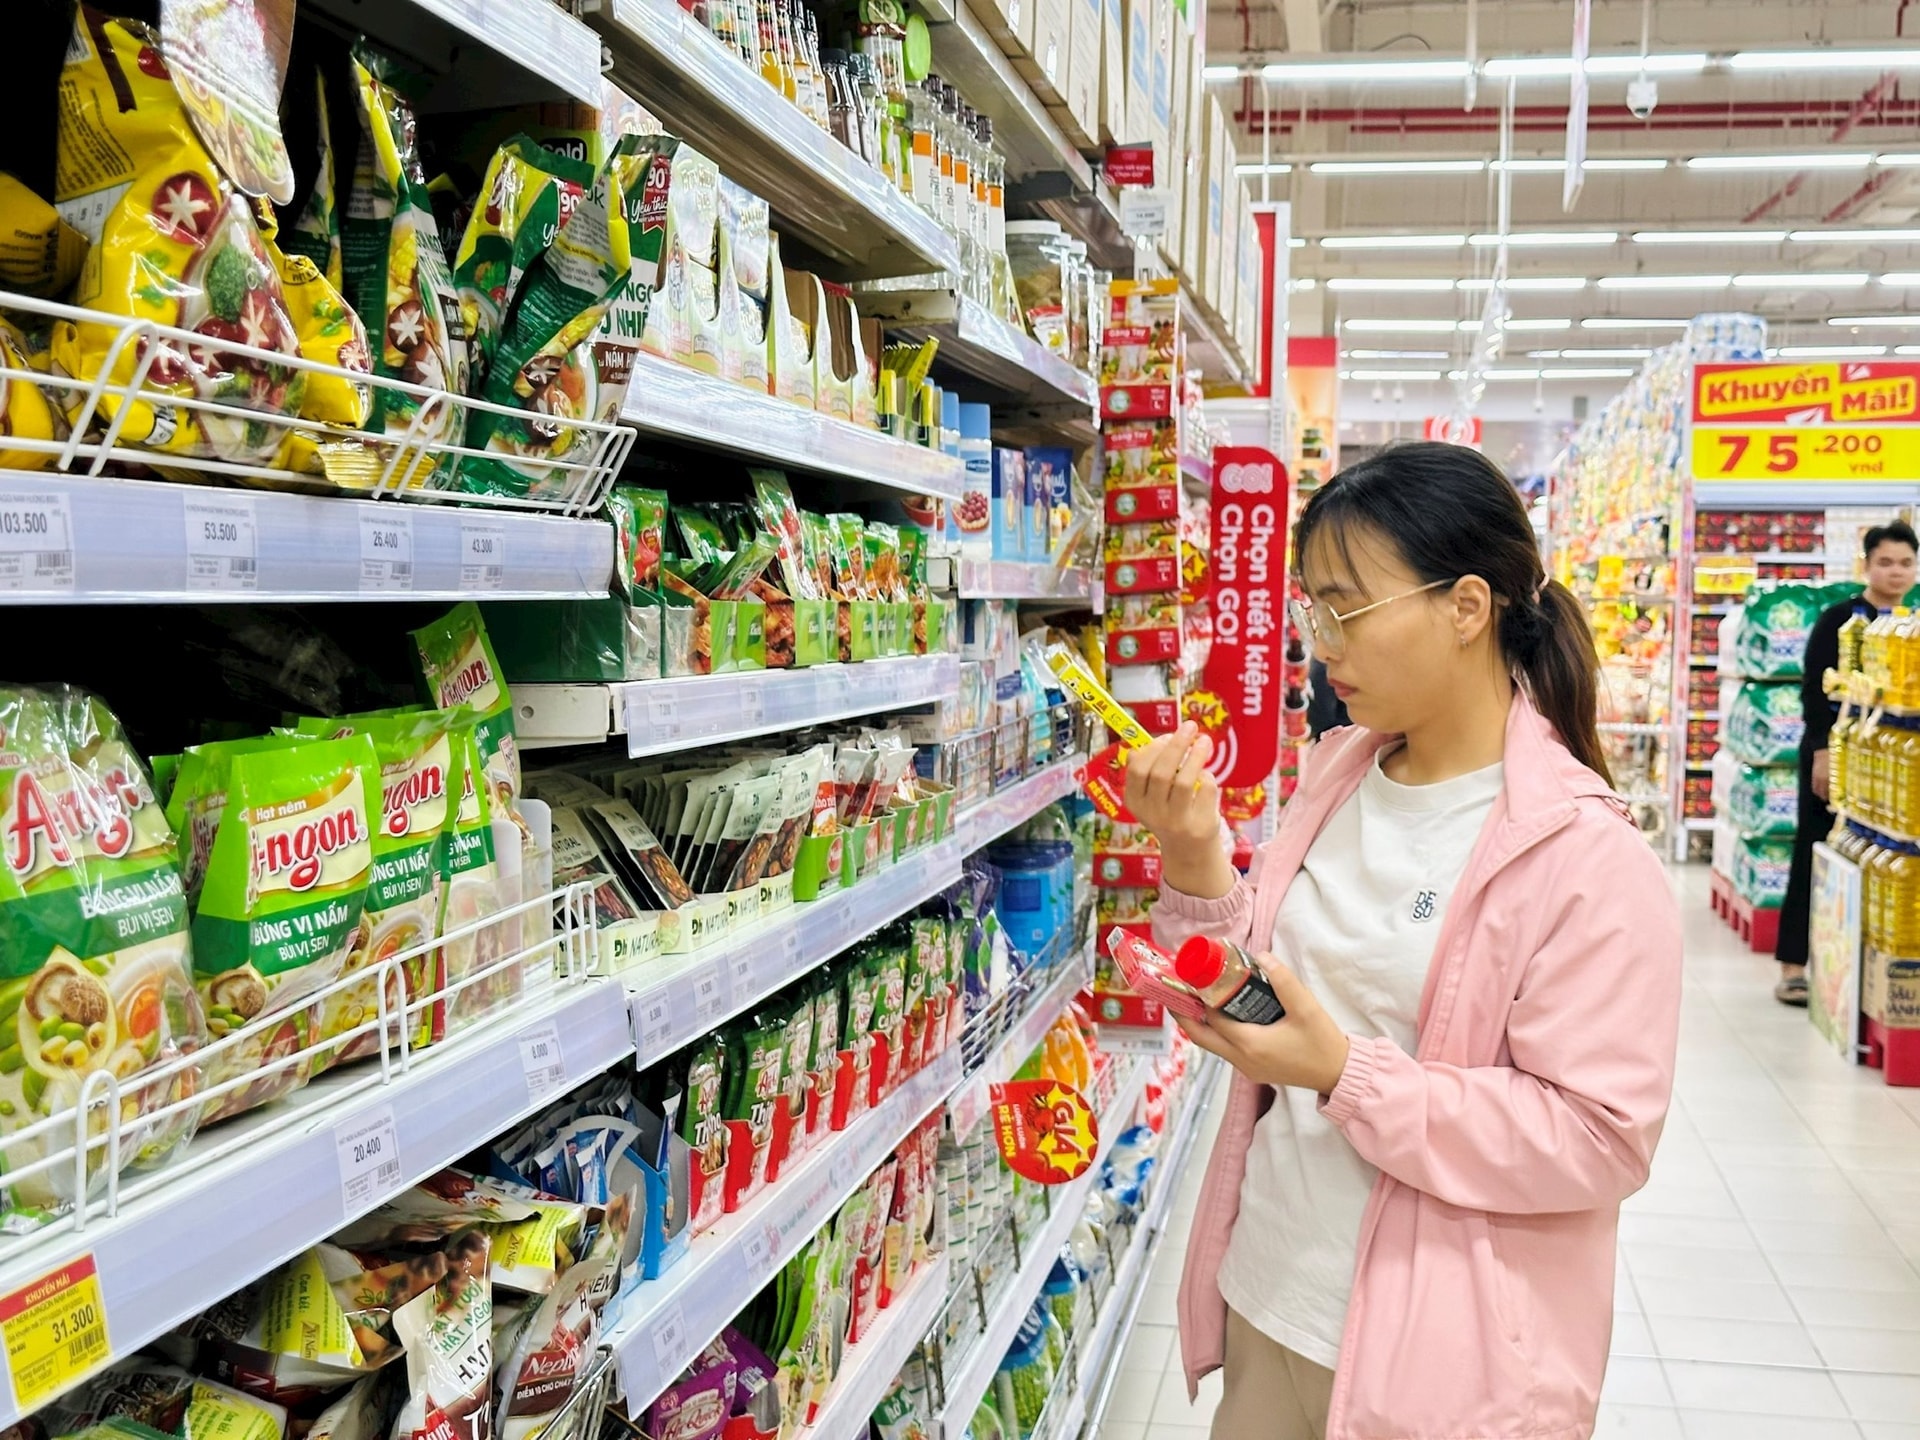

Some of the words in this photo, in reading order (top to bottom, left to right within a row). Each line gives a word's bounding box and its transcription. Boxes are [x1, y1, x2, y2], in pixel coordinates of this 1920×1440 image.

[1707, 368, 1830, 405] Khuyến
[204, 521, 238, 542] 53.500
[372, 530, 398, 549] 26.400
[471, 538, 493, 553] 43.300
[1213, 502, 1244, 582] Chọn
[1244, 503, 1275, 583] Chọn
[1215, 586, 1241, 646] GO!
[1246, 587, 1276, 639] tiết
[1238, 643, 1270, 716] kiệm
[255, 806, 276, 822] Hạt
[277, 799, 307, 816] nêm
[251, 920, 291, 946] BỪNG
[294, 915, 315, 937] VỊ
[316, 901, 348, 929] NẤM
[278, 943, 295, 961] BÙI
[310, 934, 330, 952] SEN
[353, 1136, 382, 1164] 20.400
[25, 1278, 56, 1306] KHUYẾN
[52, 1303, 94, 1344] 31.300
